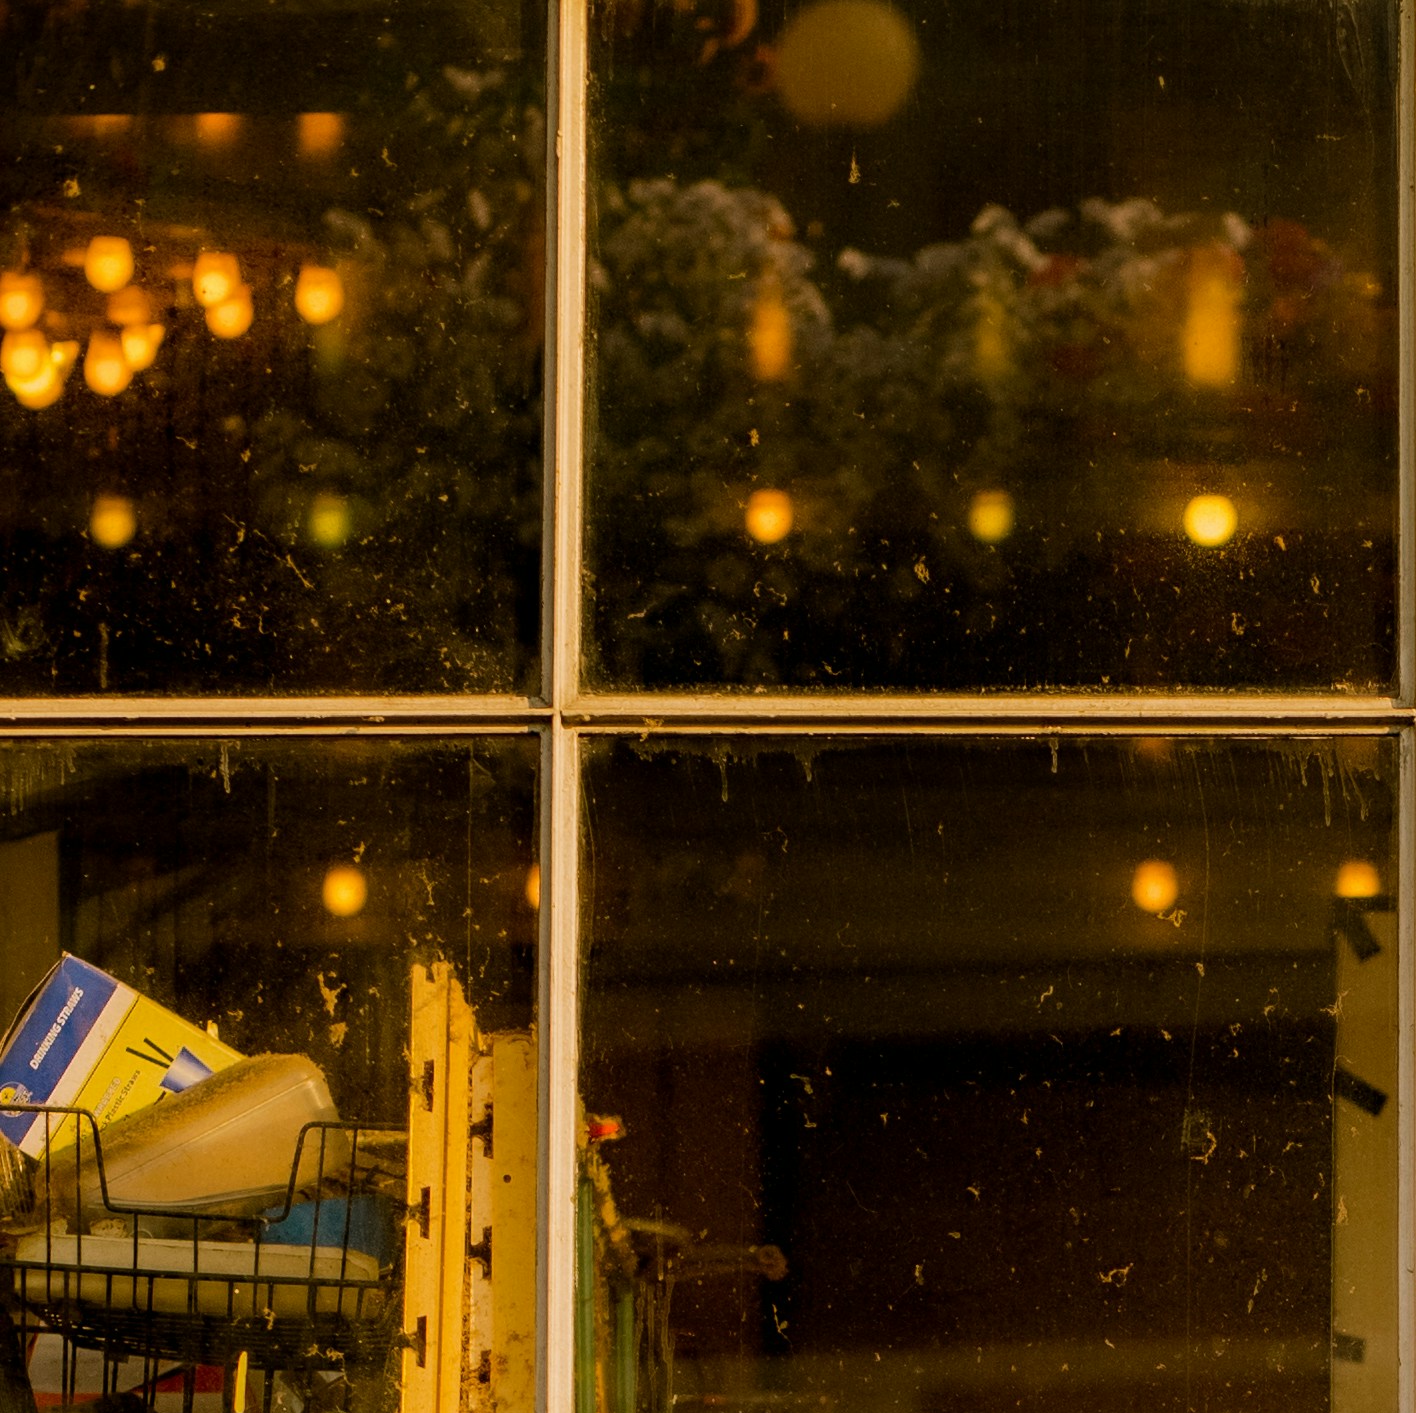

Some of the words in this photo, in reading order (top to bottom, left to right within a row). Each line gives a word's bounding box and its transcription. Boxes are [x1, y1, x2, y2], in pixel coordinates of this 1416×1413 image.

[30, 1024, 62, 1070] DRINKING
[57, 987, 84, 1027] STRAWS
[105, 1094, 125, 1122] Plastic
[121, 1069, 141, 1097] Straws
